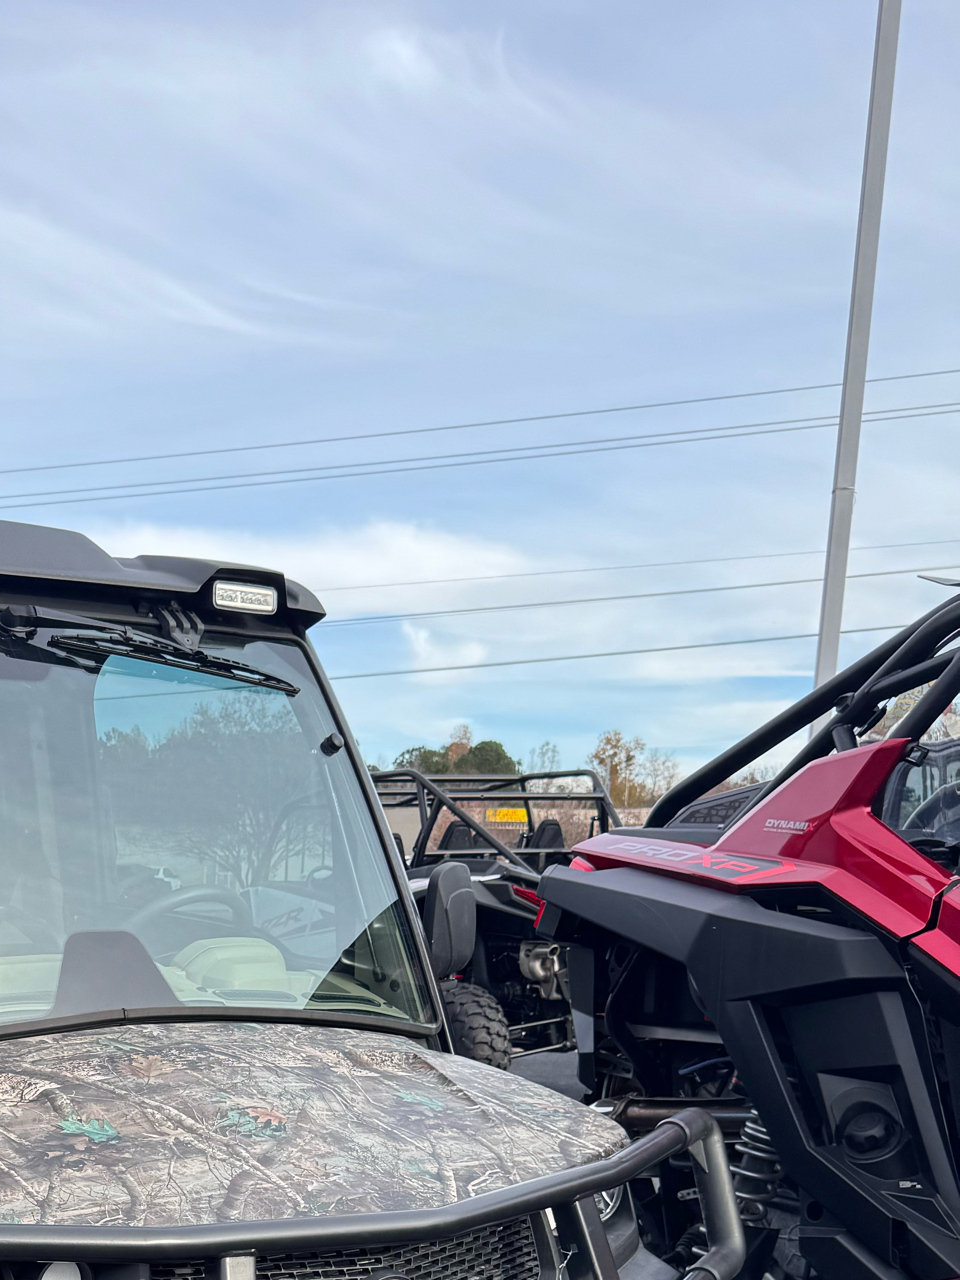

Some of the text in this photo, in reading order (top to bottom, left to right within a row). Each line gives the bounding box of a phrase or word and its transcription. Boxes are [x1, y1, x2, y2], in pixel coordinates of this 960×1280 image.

[764, 819, 819, 833] DYNAMIX
[607, 842, 760, 873] PRO XP
